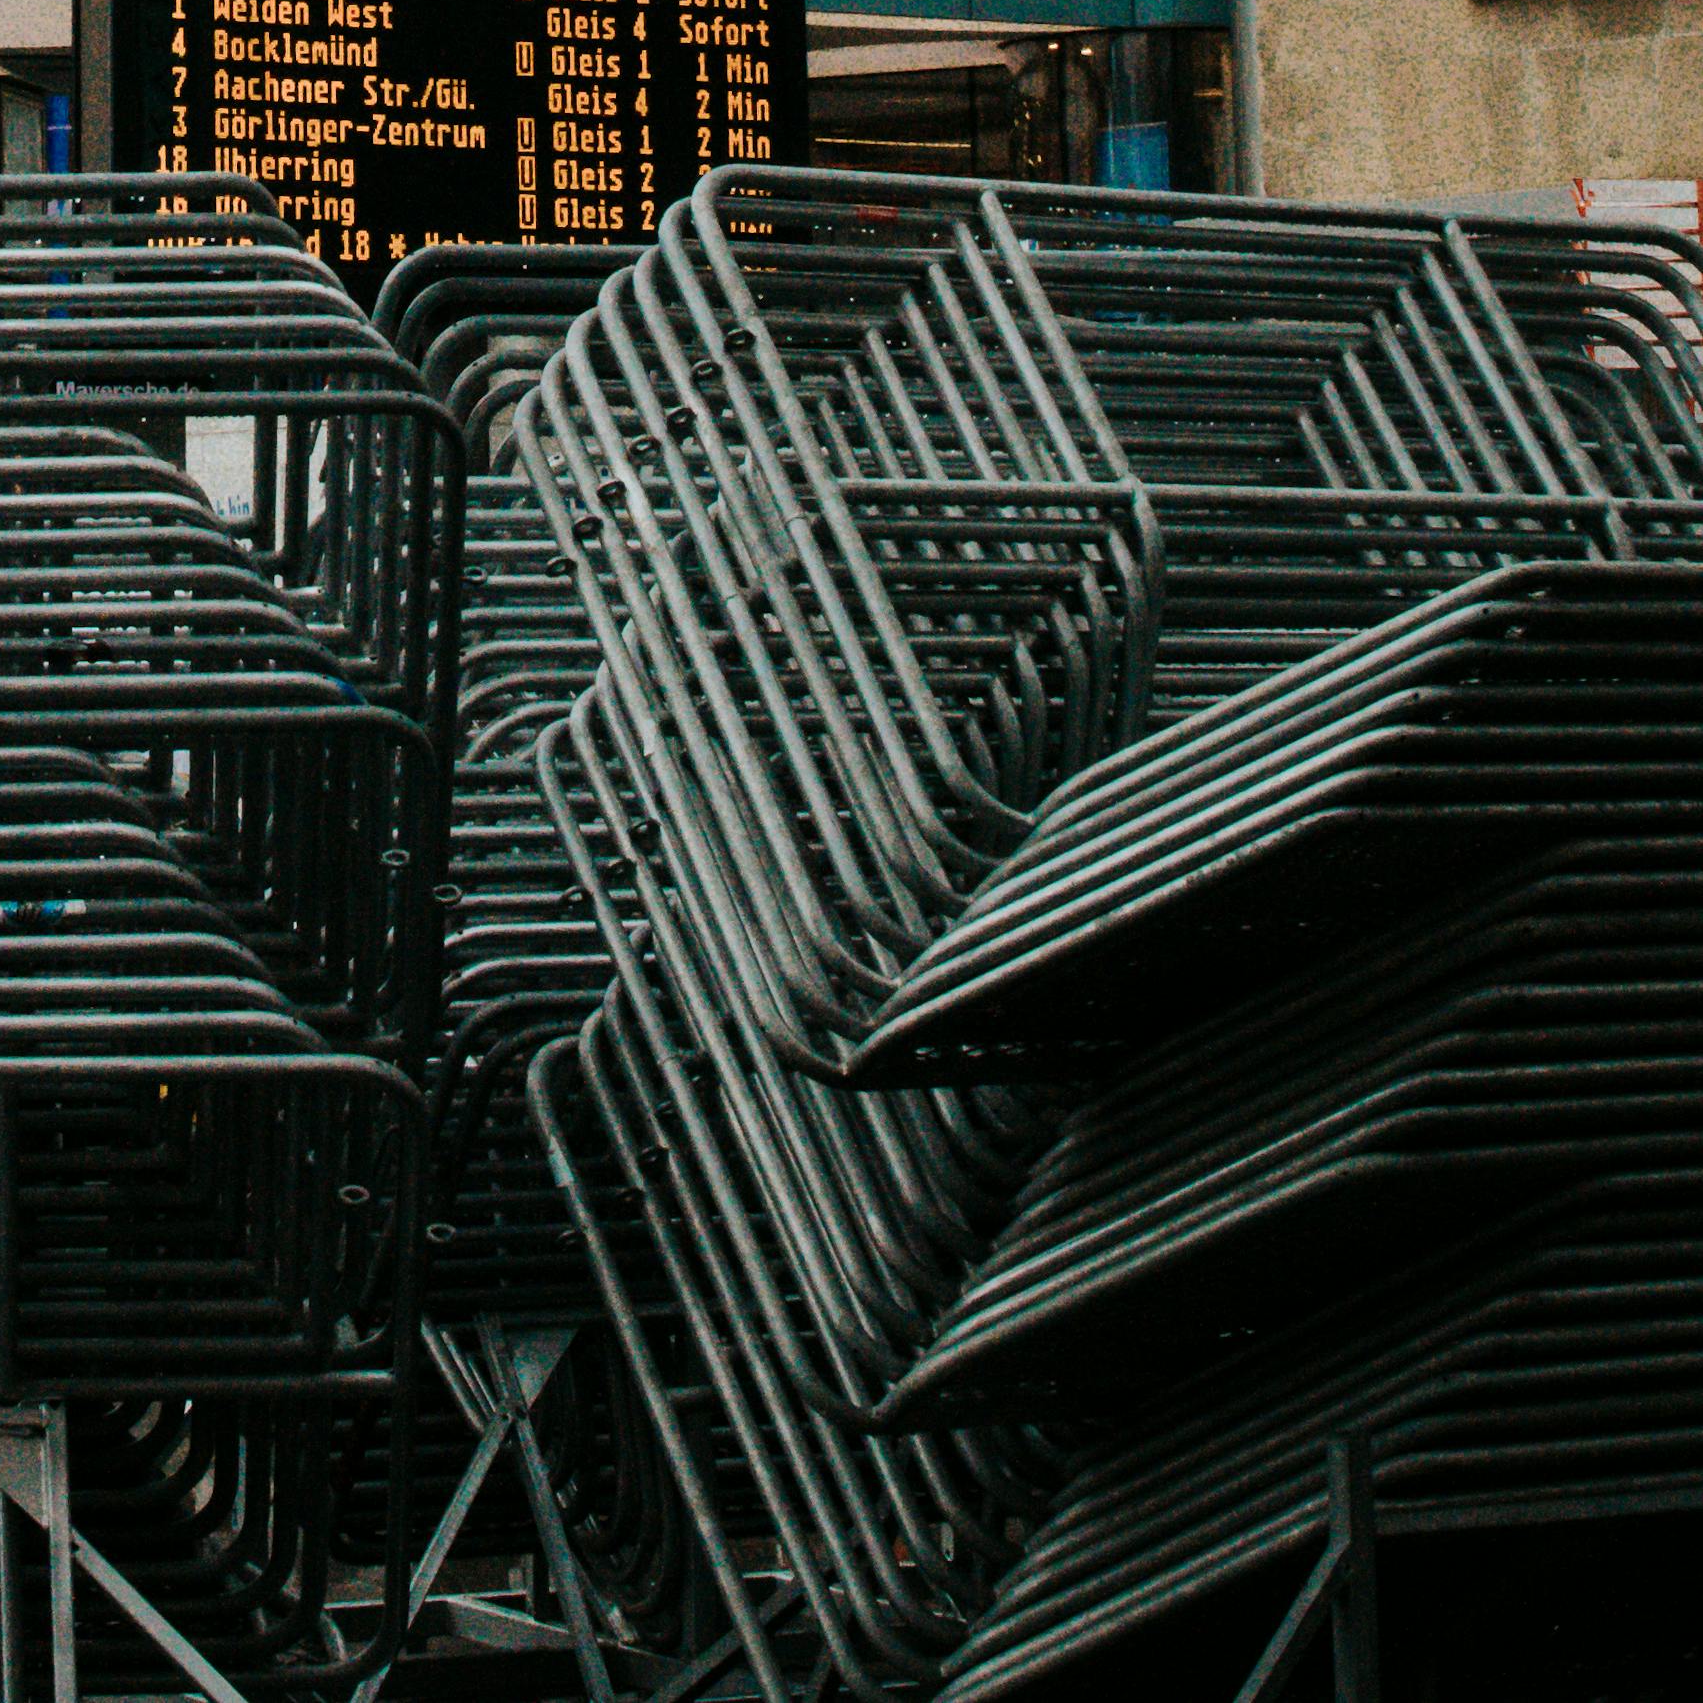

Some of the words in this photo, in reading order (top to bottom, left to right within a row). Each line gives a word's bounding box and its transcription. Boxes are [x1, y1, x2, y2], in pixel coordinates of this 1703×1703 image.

[547, 8, 615, 39] Gleis
[634, 12, 646, 41] 4
[680, 17, 769, 46] Sofort
[172, 29, 186, 56] 4
[215, 27, 377, 67] Bocklemünd
[552, 47, 620, 77] Gleis
[638, 51, 651, 79] 1
[696, 54, 708, 81] 1
[727, 54, 768, 84] Min
[172, 67, 186, 97] 7
[215, 69, 344, 104] Aachener
[549, 84, 616, 115] Gleis
[635, 89, 648, 116] 4
[697, 91, 710, 119] 2
[728, 91, 769, 121] Min
[173, 106, 187, 137] 3
[215, 105, 485, 151] Görlinger-Zentrum
[553, 122, 621, 153] Gleis
[640, 126, 653, 154] 1
[698, 129, 711, 157] 2
[729, 129, 770, 158] Min
[156, 145, 187, 174] 18
[215, 145, 354, 187] Ubierring
[554, 160, 622, 191] Gleis
[641, 163, 654, 192] 2
[555, 198, 623, 229] Gleis
[641, 201, 654, 230] 2
[340, 230, 369, 260] 18
